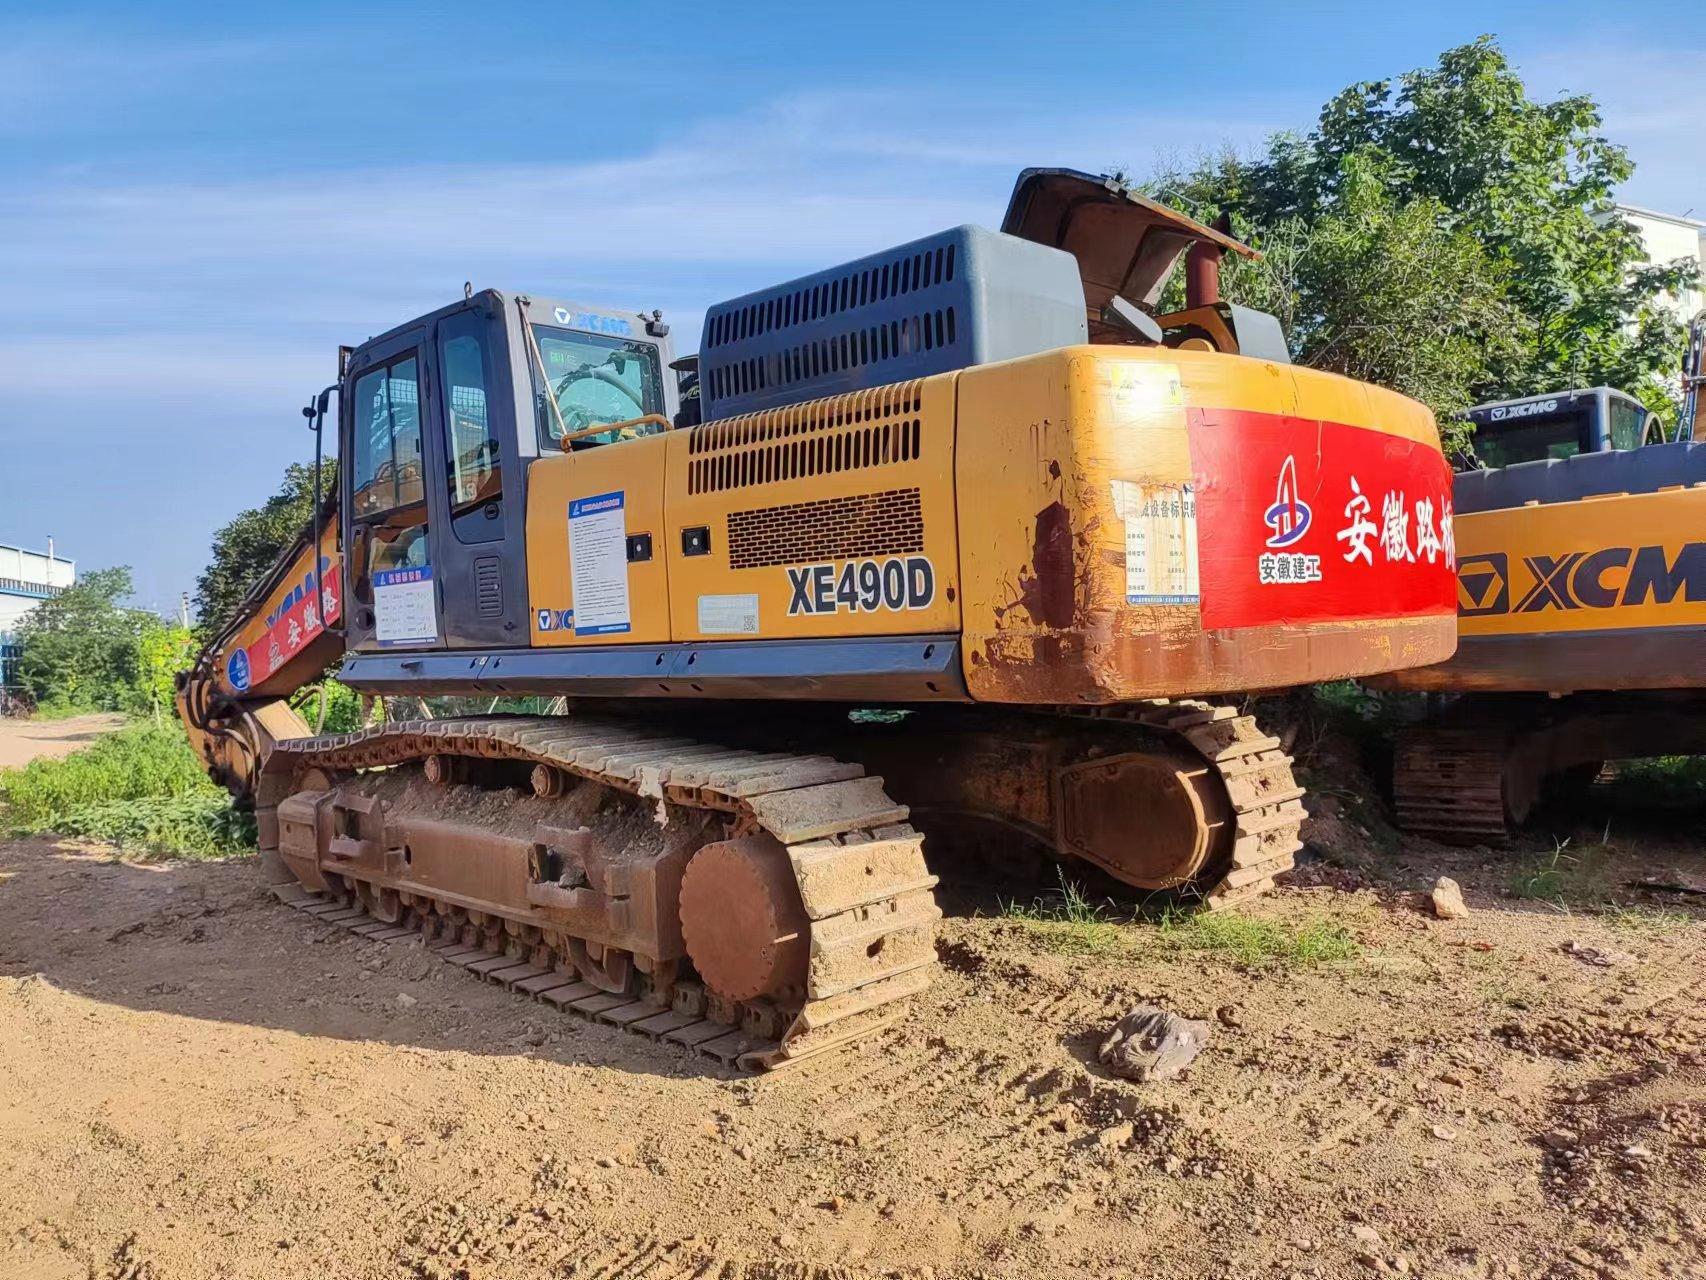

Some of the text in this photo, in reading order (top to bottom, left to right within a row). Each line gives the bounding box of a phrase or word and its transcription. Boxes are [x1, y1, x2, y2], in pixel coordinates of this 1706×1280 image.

[1506, 399, 1558, 418] XCMG
[1260, 555, 1321, 582] 安徽建工
[786, 557, 935, 616] XE490D
